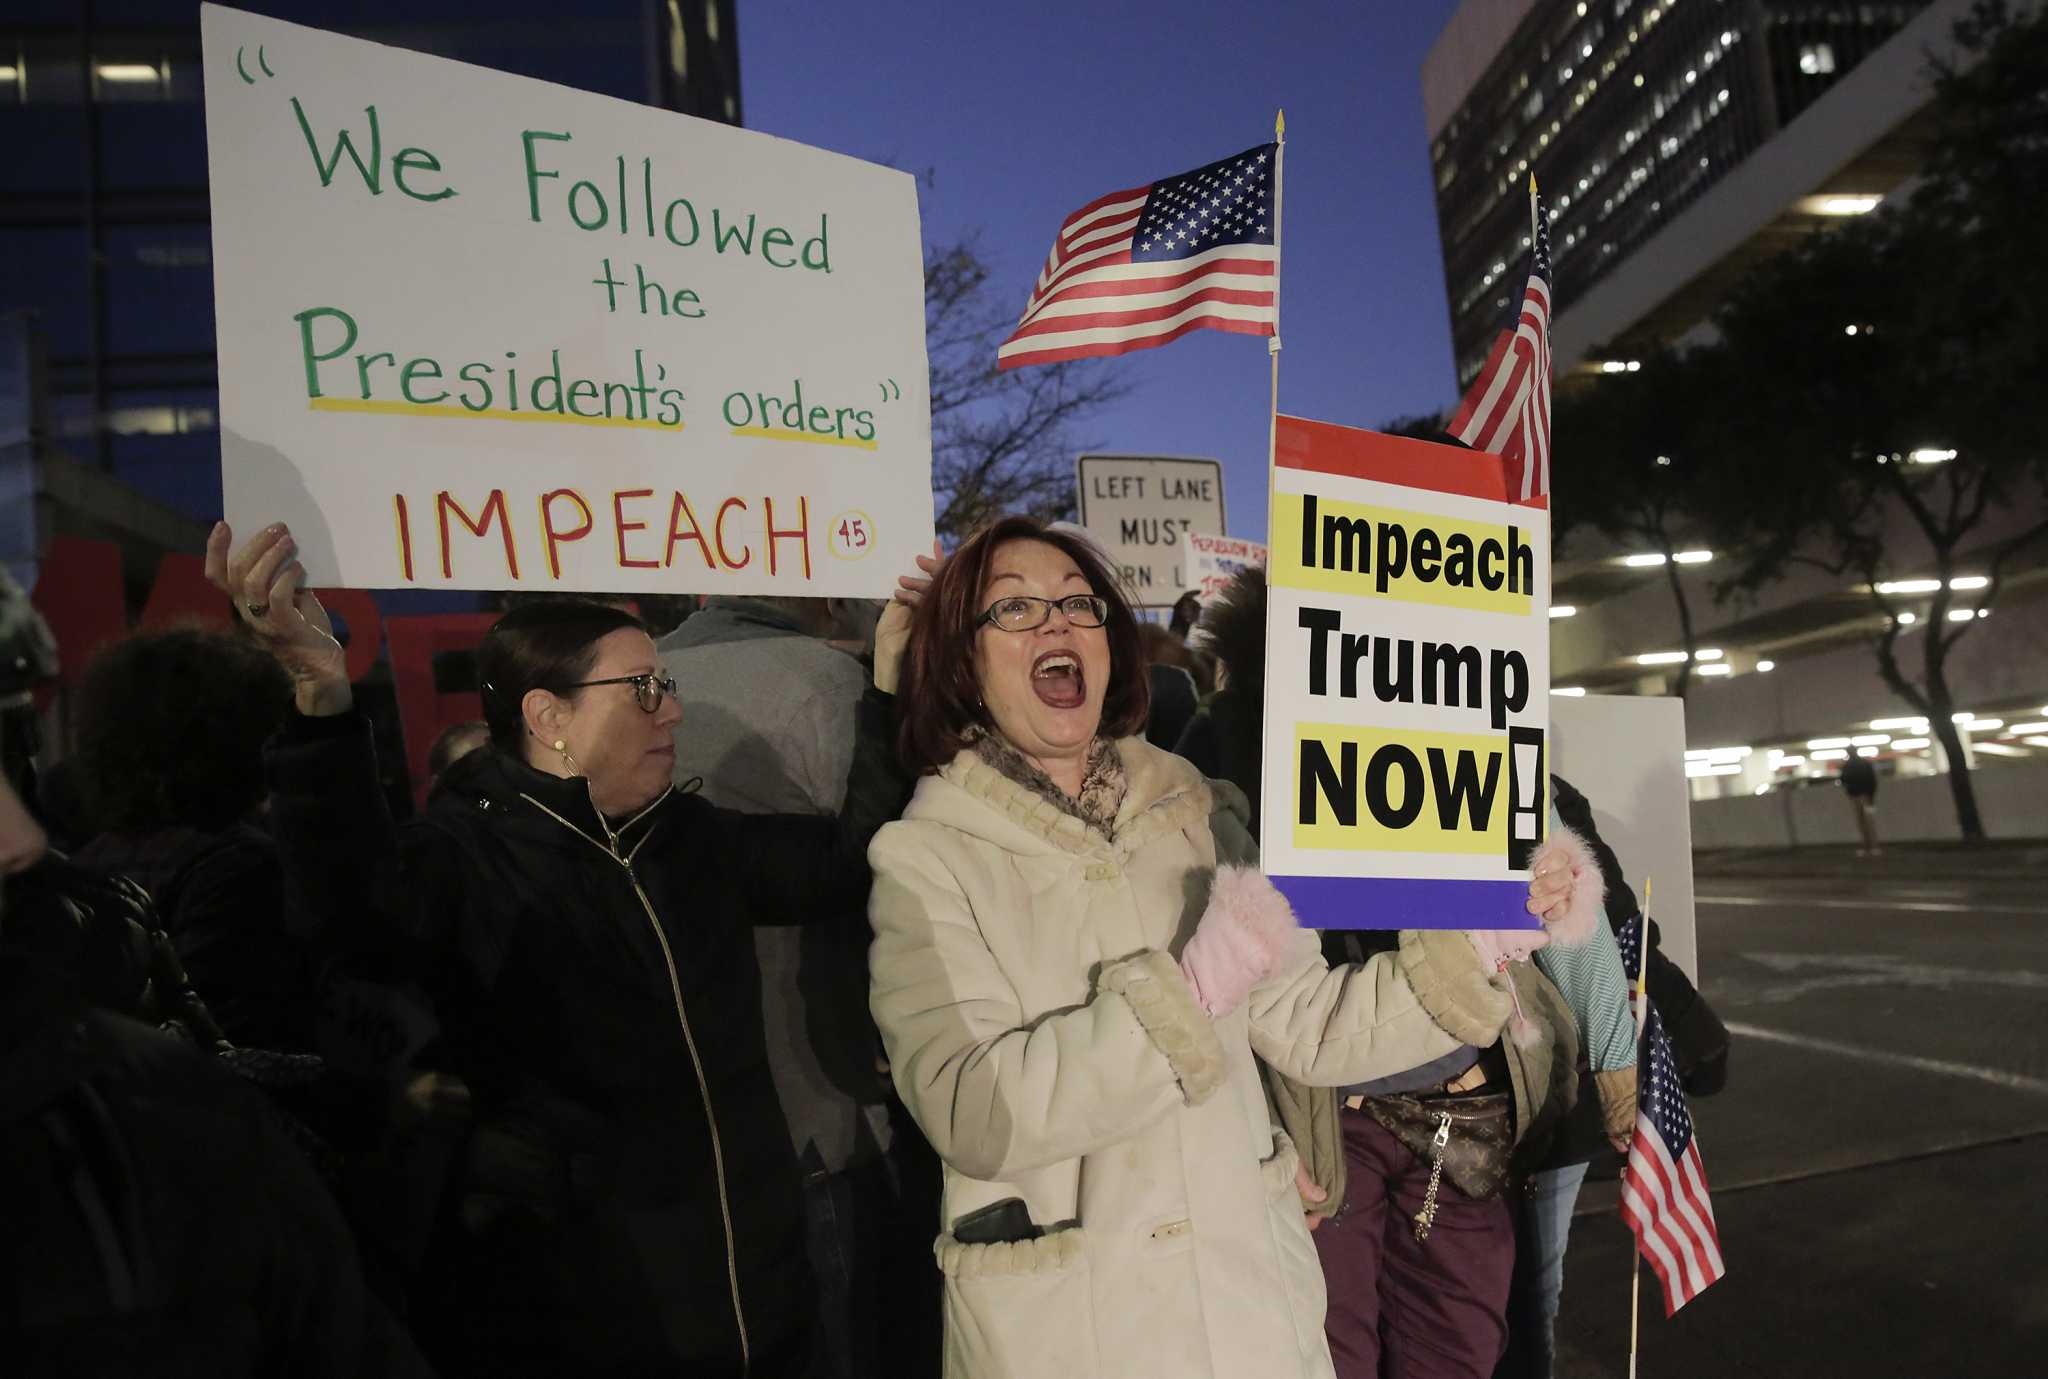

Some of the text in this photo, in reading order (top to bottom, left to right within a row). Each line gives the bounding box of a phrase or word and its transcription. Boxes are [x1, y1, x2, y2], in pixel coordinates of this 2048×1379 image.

[521, 130, 834, 274] Followed
[593, 258, 707, 319] the
[294, 307, 685, 427] President's
[393, 487, 867, 581] IMPEACH 45
[1094, 476, 1213, 502] LEFT LANE
[1301, 494, 1534, 596] Impeach
[1298, 606, 1530, 731] Trump
[1299, 735, 1542, 843] NOW!
